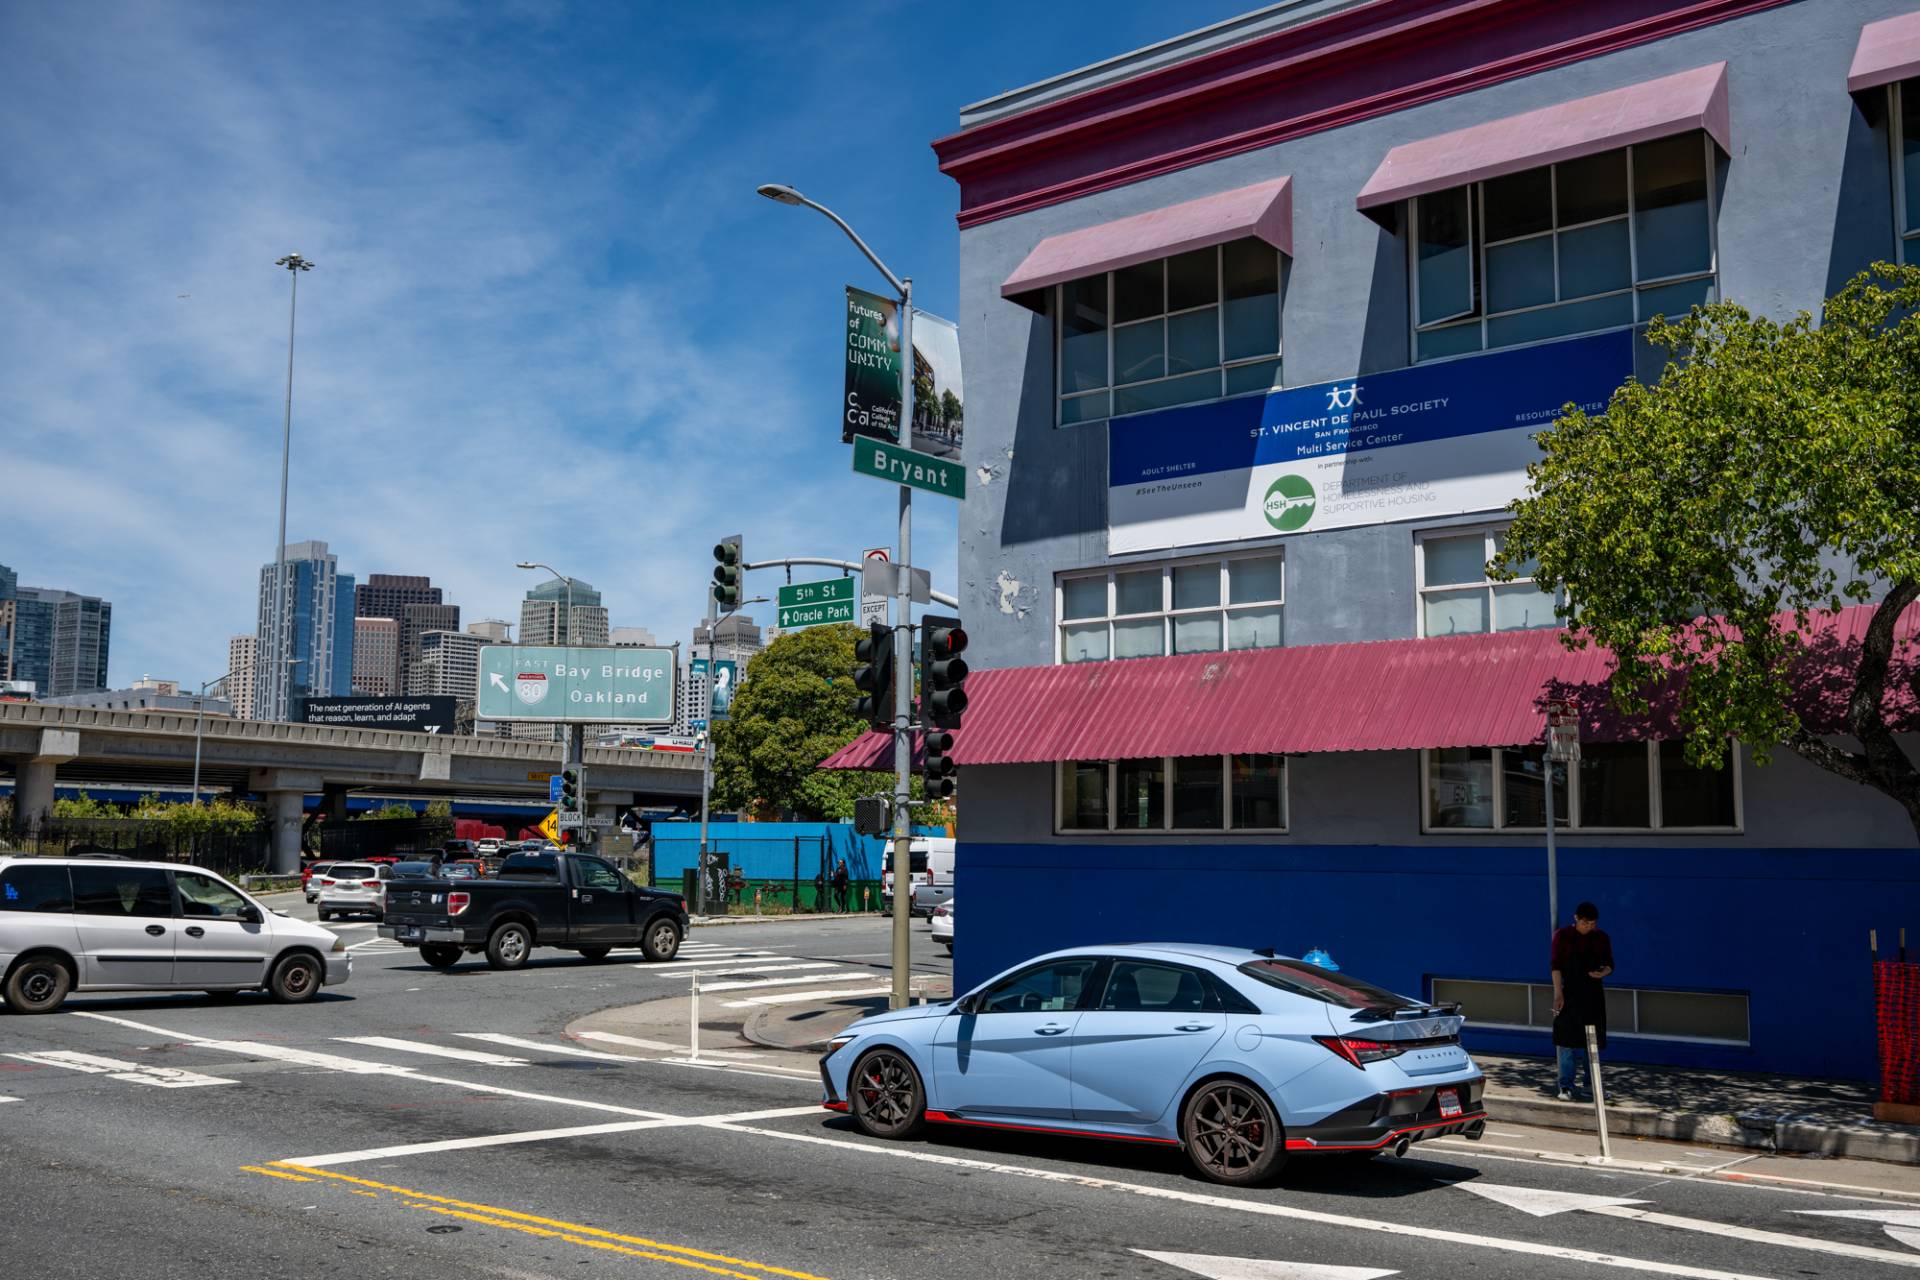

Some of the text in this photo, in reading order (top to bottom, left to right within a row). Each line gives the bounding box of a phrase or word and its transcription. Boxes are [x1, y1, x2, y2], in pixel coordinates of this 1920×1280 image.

[849, 301, 884, 320] Futures
[849, 318, 860, 329] of
[848, 332, 887, 354] COMM
[848, 348, 892, 371] UNITY
[871, 405, 897, 416] California
[871, 412, 891, 423] College
[1250, 397, 1449, 438] ST. VINCENT DE PAUL SOCIETY
[1515, 408, 1562, 421] RESOURCE
[1297, 432, 1404, 456] Multi Service Center
[873, 449, 948, 488] Bryant
[1142, 462, 1197, 476] ADULT SHELTER
[1324, 458, 1358, 470] partnership
[1136, 481, 1203, 496] #SeeTheUnseen
[1322, 472, 1408, 492] DEPARTMENT OF
[1322, 481, 1430, 503] HOMELESSNESS AND
[1266, 500, 1287, 511] HSH
[1324, 492, 1437, 515] SUPPORTIVE HOUSING
[796, 584, 836, 601] 5th St
[792, 604, 850, 623] Oracle Park
[862, 603, 885, 615] EXCEPT
[555, 664, 664, 680] Bay Bridge
[520, 683, 541, 698] 80
[569, 689, 649, 704] Oakland
[309, 704, 324, 712] The
[324, 704, 341, 712] next
[342, 704, 383, 713] generation
[384, 703, 394, 711] of
[403, 704, 431, 713] agents
[308, 713, 416, 723] that reason, learn, and adapt
[560, 813, 580, 822] BLOCK
[547, 820, 557, 831] 14
